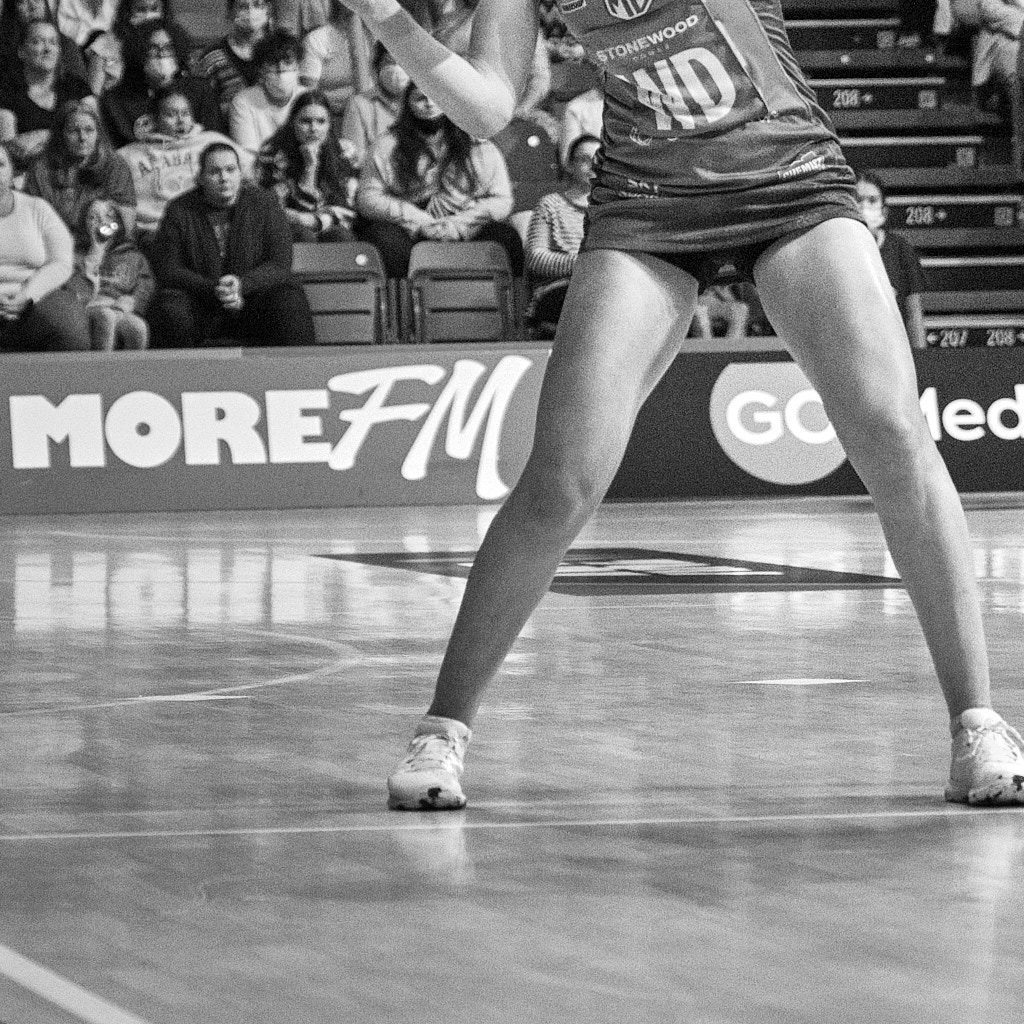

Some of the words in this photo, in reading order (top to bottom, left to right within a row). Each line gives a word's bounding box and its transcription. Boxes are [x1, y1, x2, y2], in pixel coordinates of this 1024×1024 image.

[596, 15, 699, 63] STONEWOOD
[9, 389, 333, 469] MORE
[327, 355, 533, 500] FM
